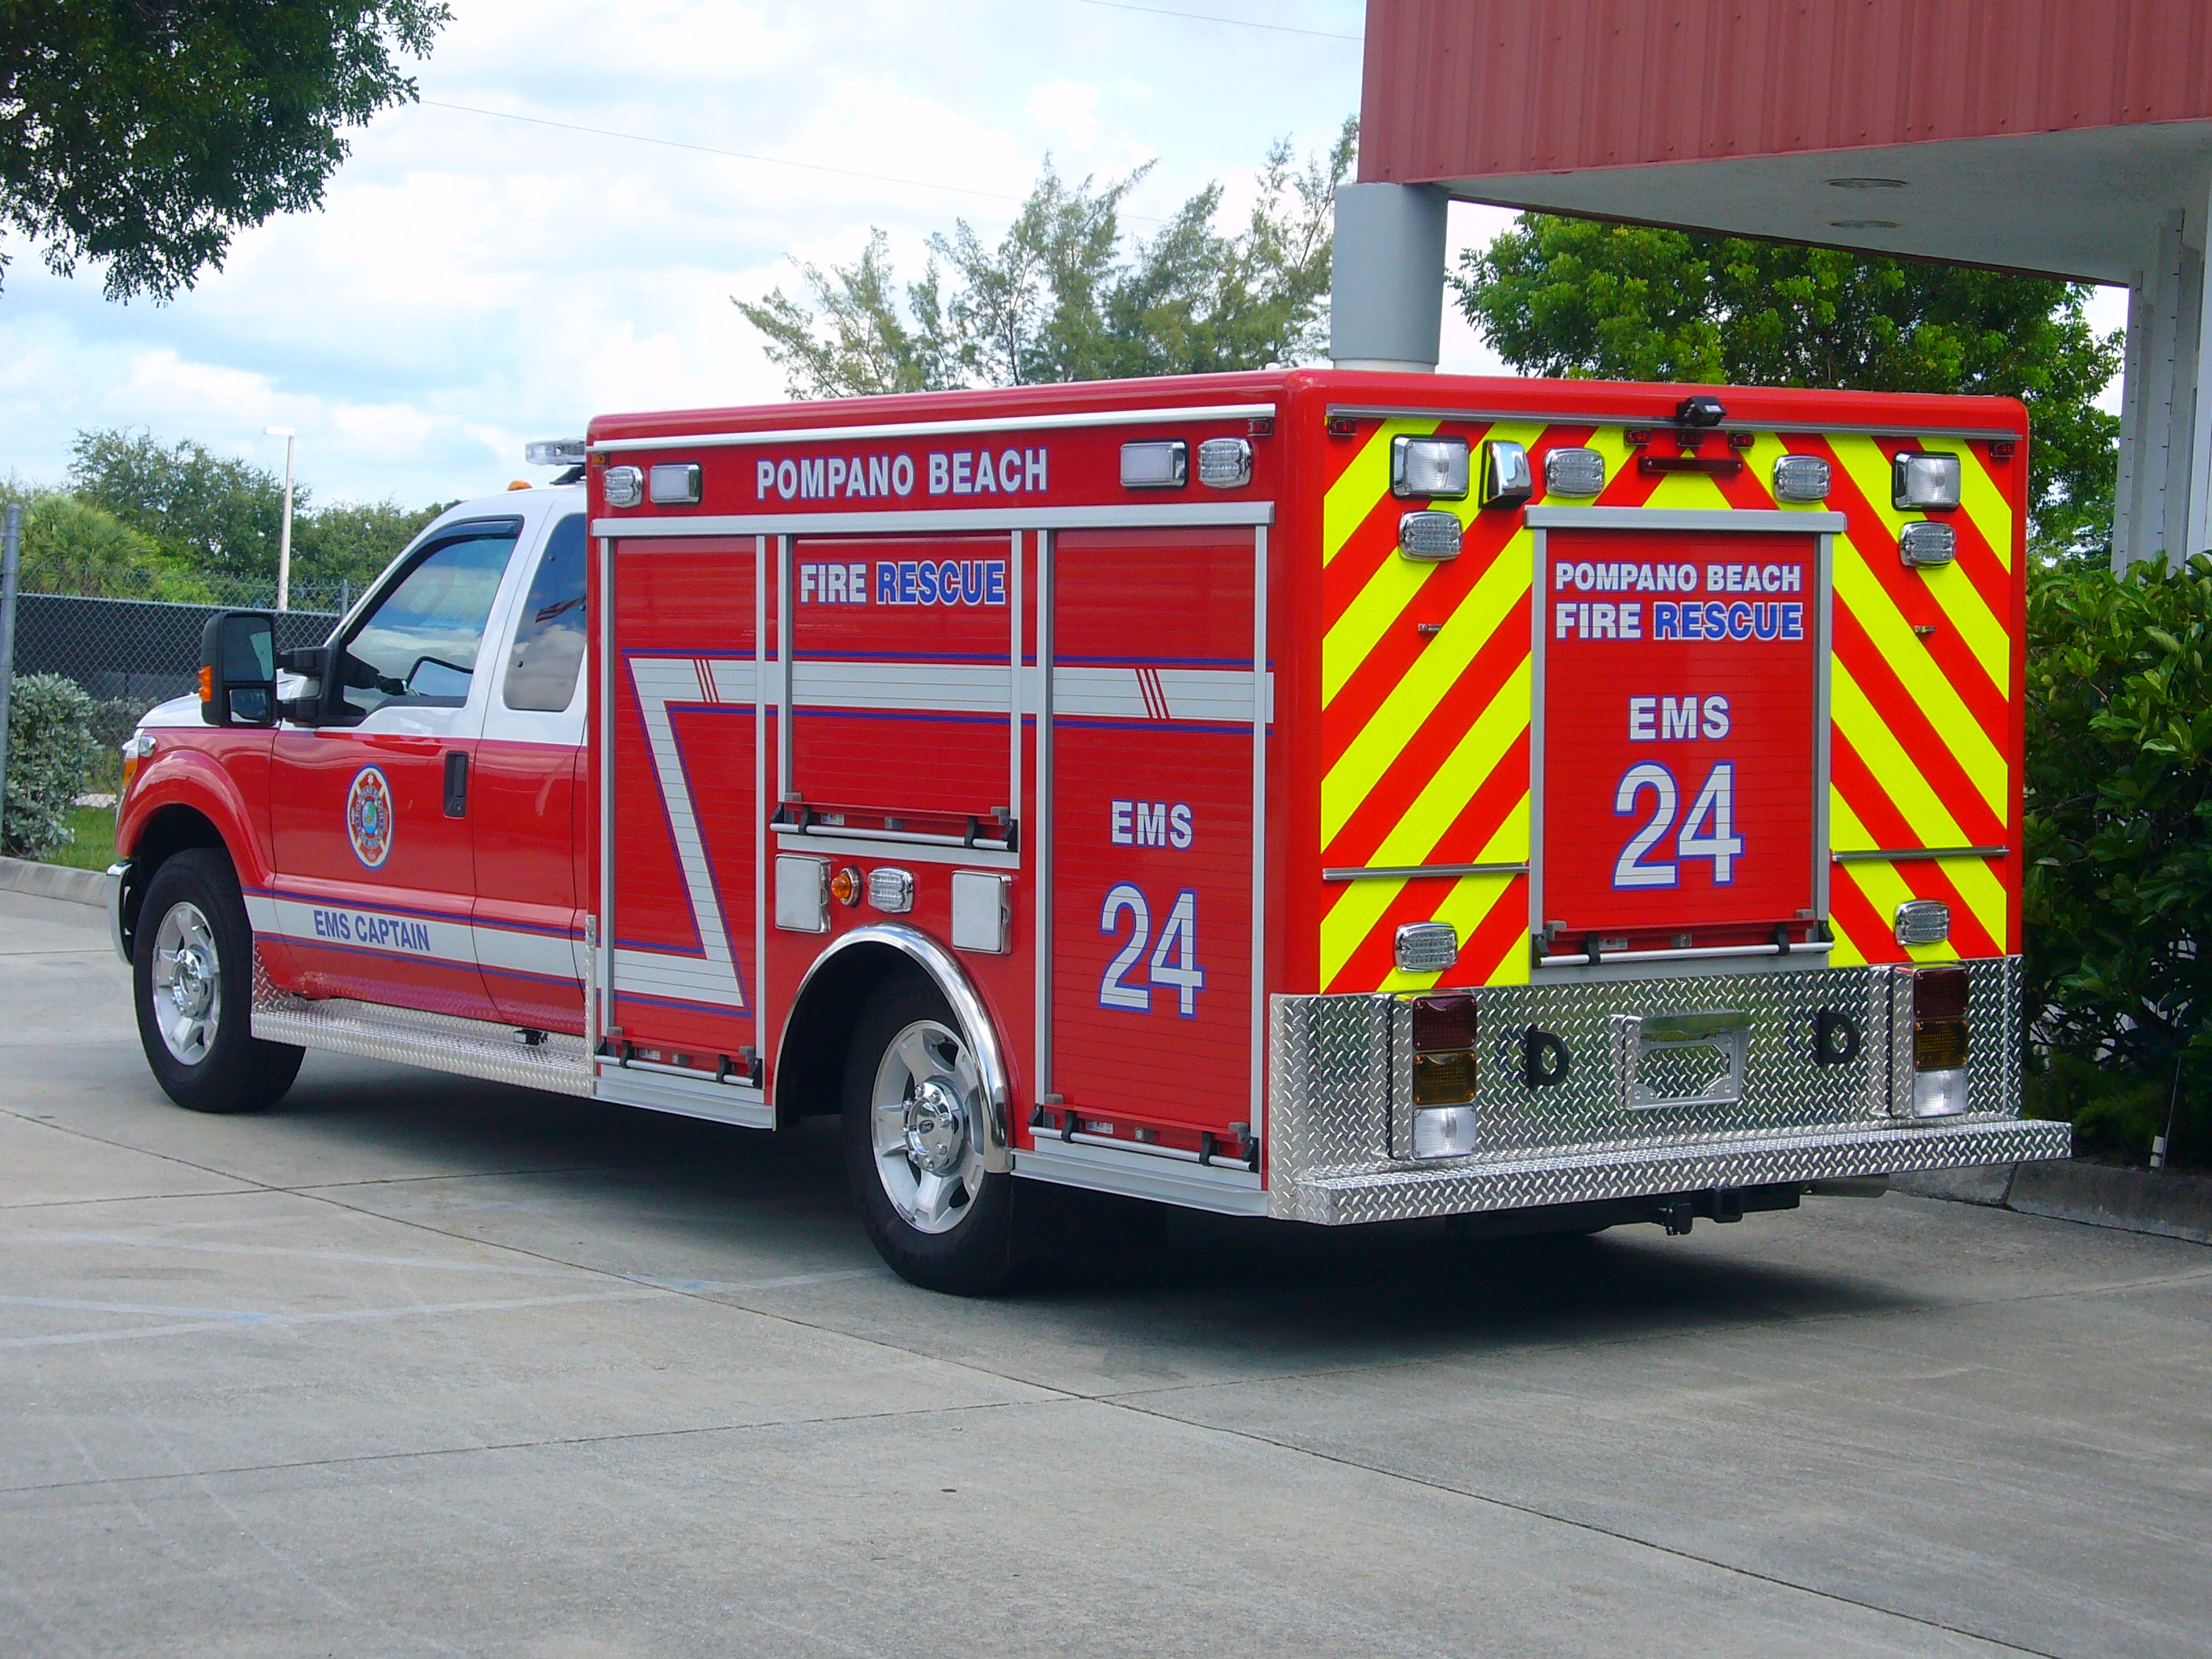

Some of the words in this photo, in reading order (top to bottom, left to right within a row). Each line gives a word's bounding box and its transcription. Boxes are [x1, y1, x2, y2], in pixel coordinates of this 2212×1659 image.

[756, 452, 915, 500] POMPANO
[928, 447, 1047, 496] BEACH
[799, 562, 867, 603] FIRE
[876, 559, 1005, 605] RESCUE
[1555, 561, 1697, 592] POMPANO
[1705, 562, 1802, 593] BEACH
[1555, 602, 1643, 639] FIRE
[1653, 601, 1804, 640] RESCUE
[1628, 695, 1731, 742] EMS
[1111, 798, 1193, 849] EMS
[1612, 760, 1745, 890] 24
[313, 909, 351, 940] EMS
[355, 915, 430, 951] CAPTAIN
[1098, 881, 1206, 1020] 24
